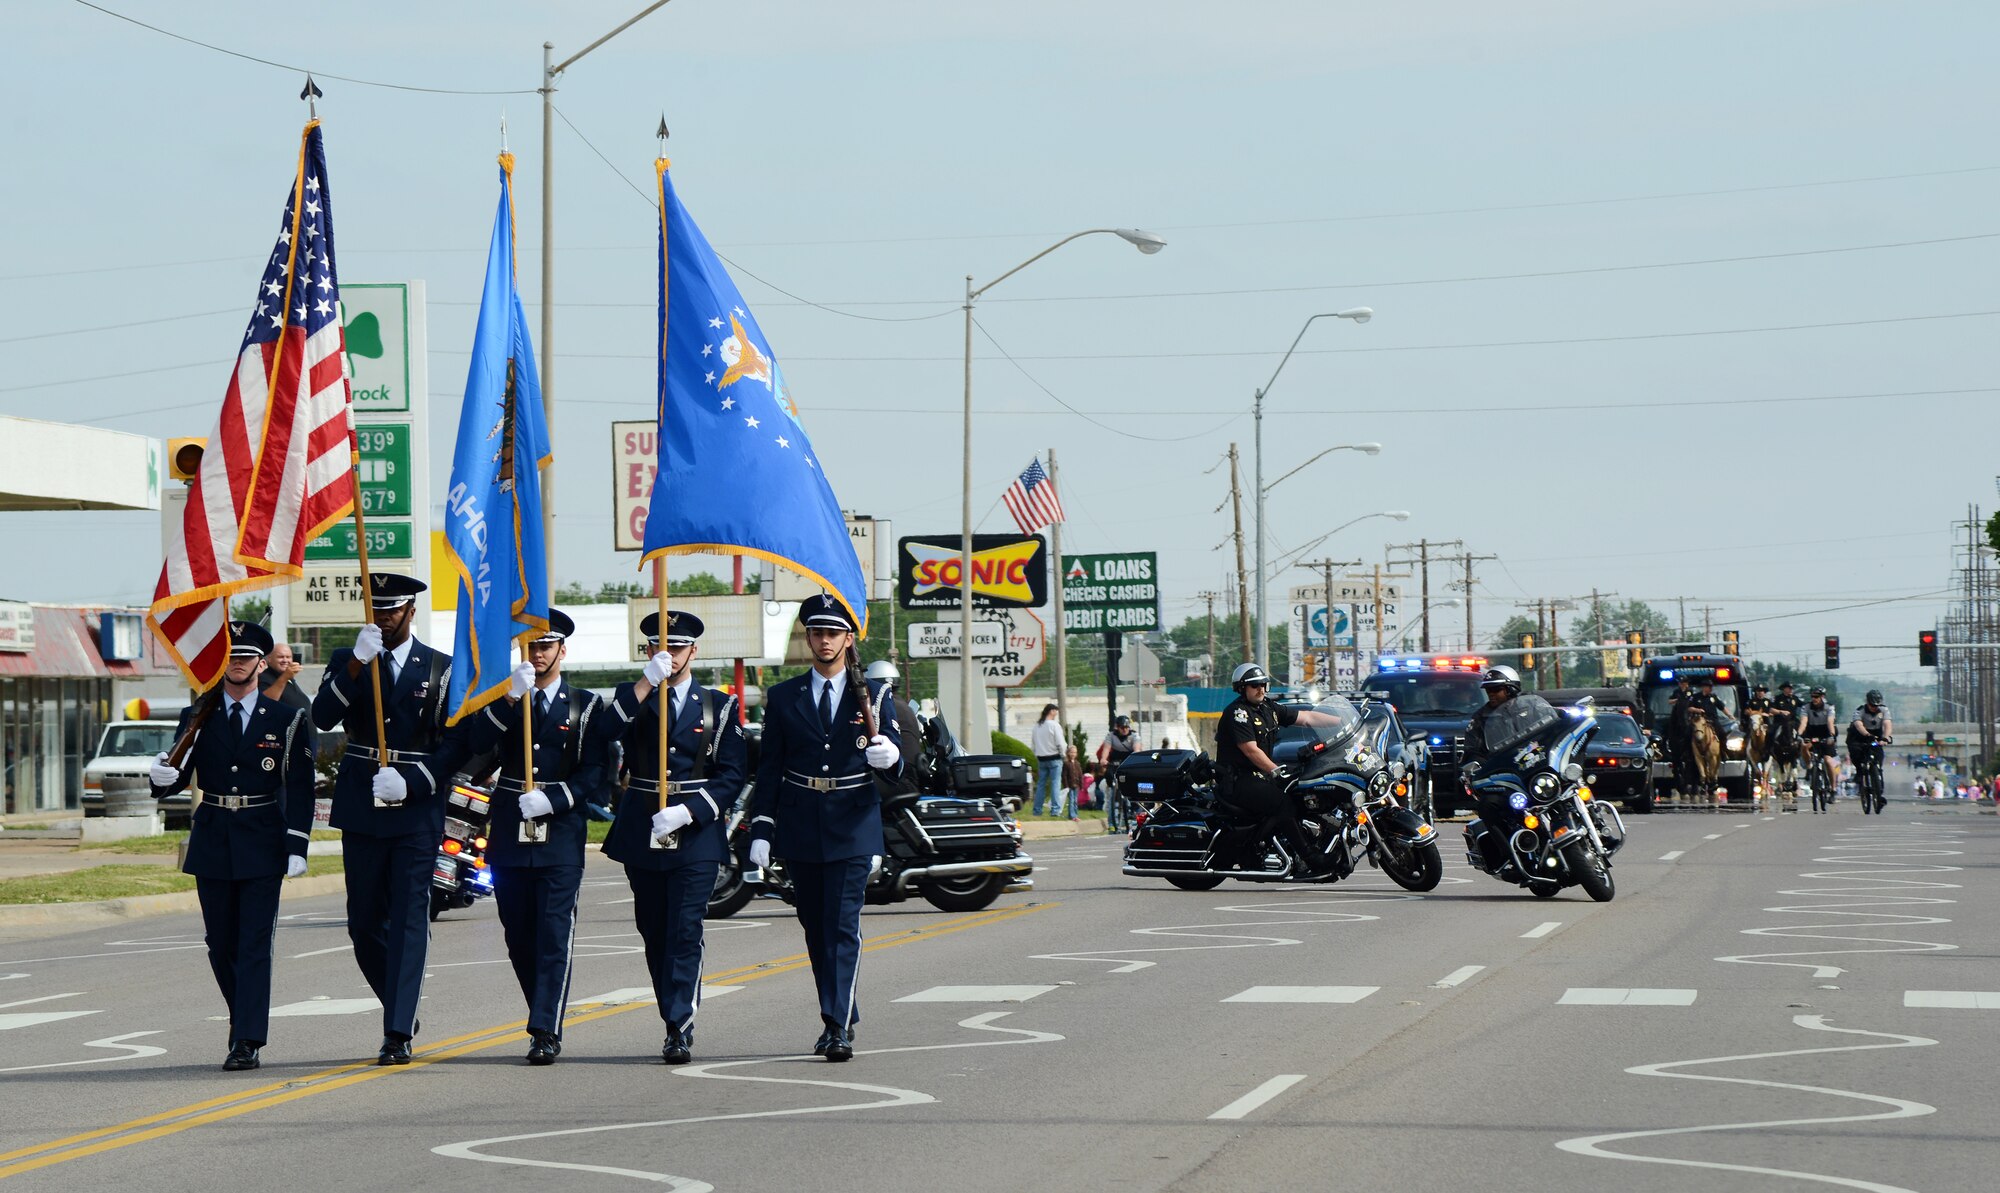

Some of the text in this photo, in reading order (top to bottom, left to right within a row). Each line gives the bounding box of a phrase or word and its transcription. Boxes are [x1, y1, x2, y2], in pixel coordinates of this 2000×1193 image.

[352, 384, 390, 400] rock
[360, 431, 395, 452] 399
[625, 432, 658, 456] SU
[626, 463, 657, 498] EX
[361, 490, 396, 510] 679
[449, 482, 491, 608] AHOMA
[917, 557, 1029, 586] SONIC
[1095, 559, 1151, 580] LOANS
[309, 577, 327, 588] AC
[306, 591, 364, 602] NOE THA
[909, 597, 951, 606] America's
[1063, 584, 1155, 602] CHECKS CASHED
[1341, 587, 1397, 599] PLAA
[1064, 607, 1156, 629] DEBIT CARDS
[924, 627, 953, 635] TRY A
[919, 635, 997, 645] ASIAGO CICKEN
[1010, 633, 1036, 650] try
[929, 646, 962, 655] SANDWI
